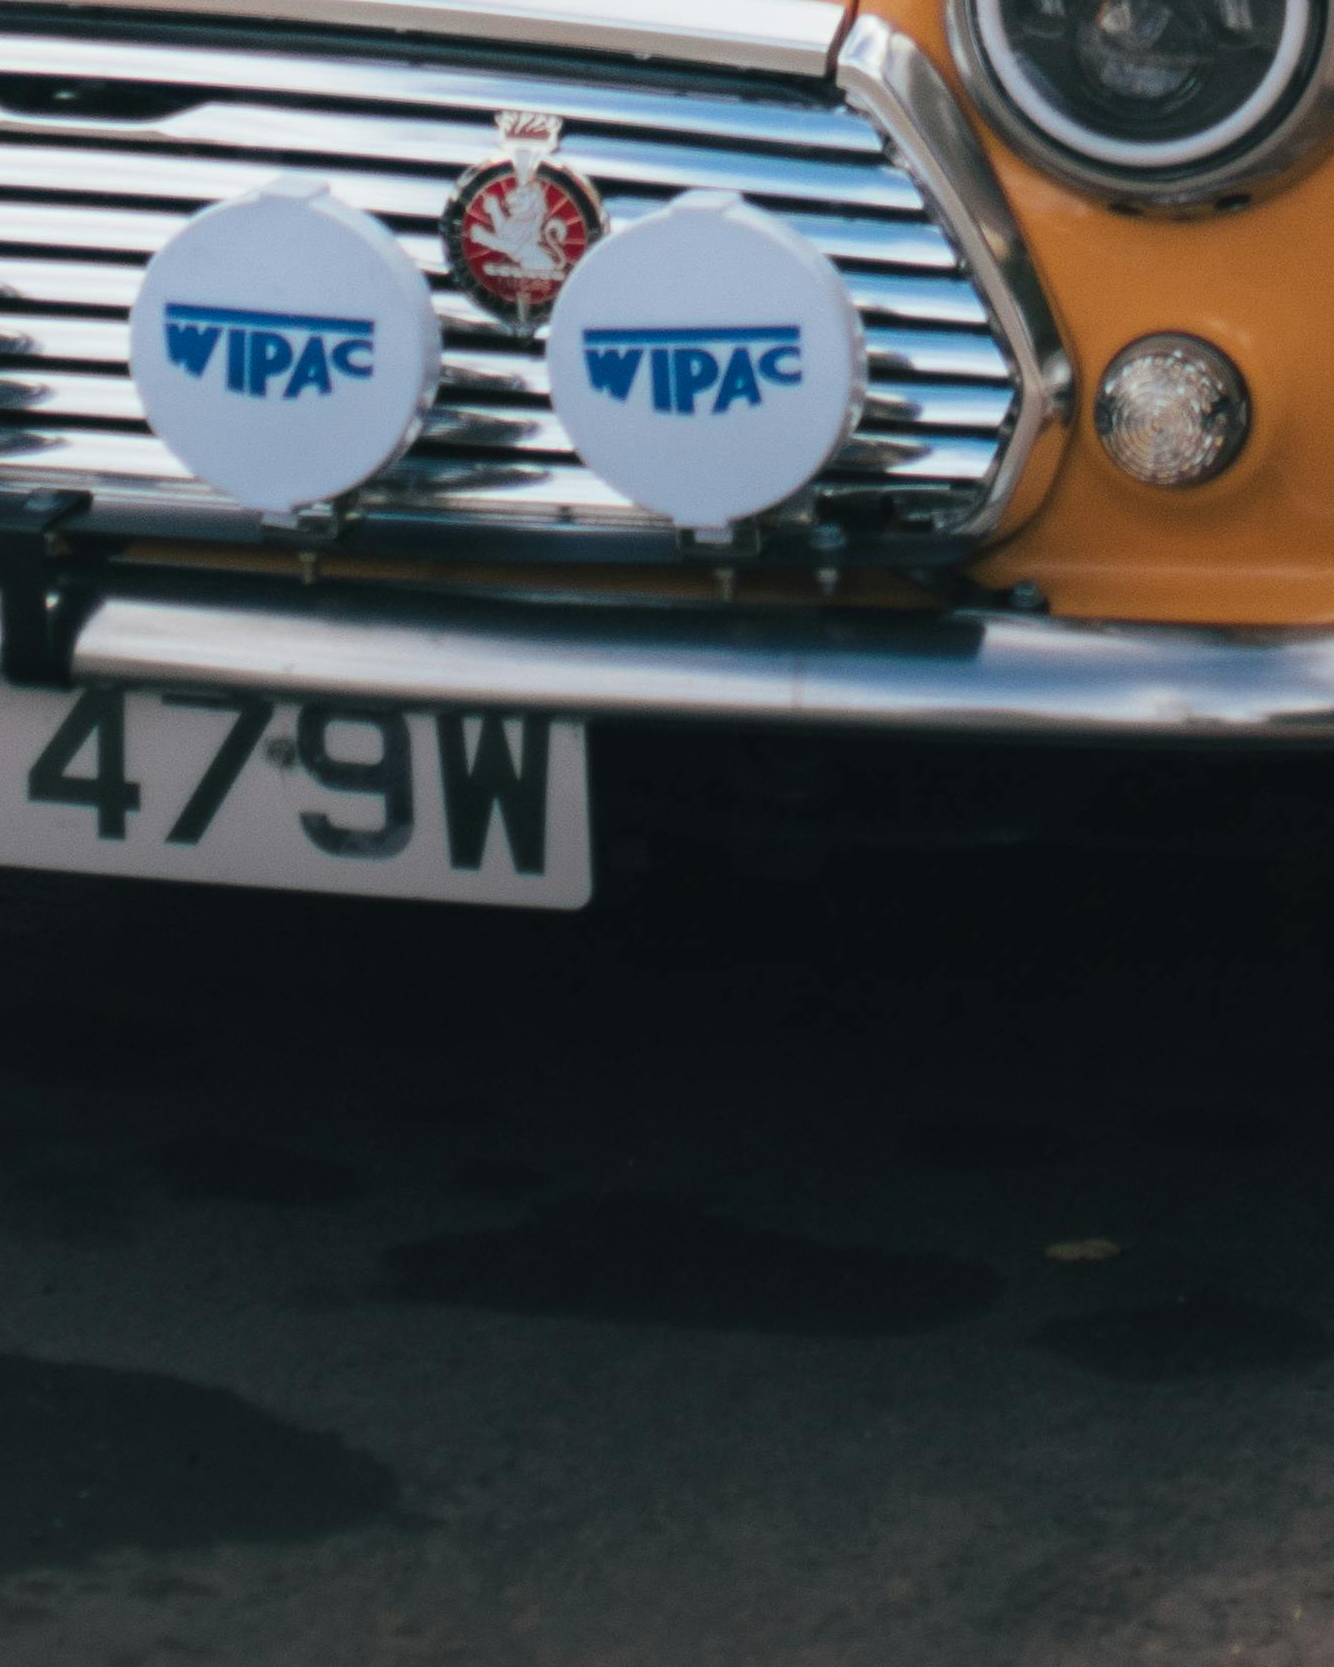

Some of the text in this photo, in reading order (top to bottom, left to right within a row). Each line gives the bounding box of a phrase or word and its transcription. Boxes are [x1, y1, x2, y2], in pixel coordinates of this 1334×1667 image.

[165, 322, 375, 400] WIPAC
[583, 345, 802, 415] WIPAC
[27, 685, 551, 866] 479W
